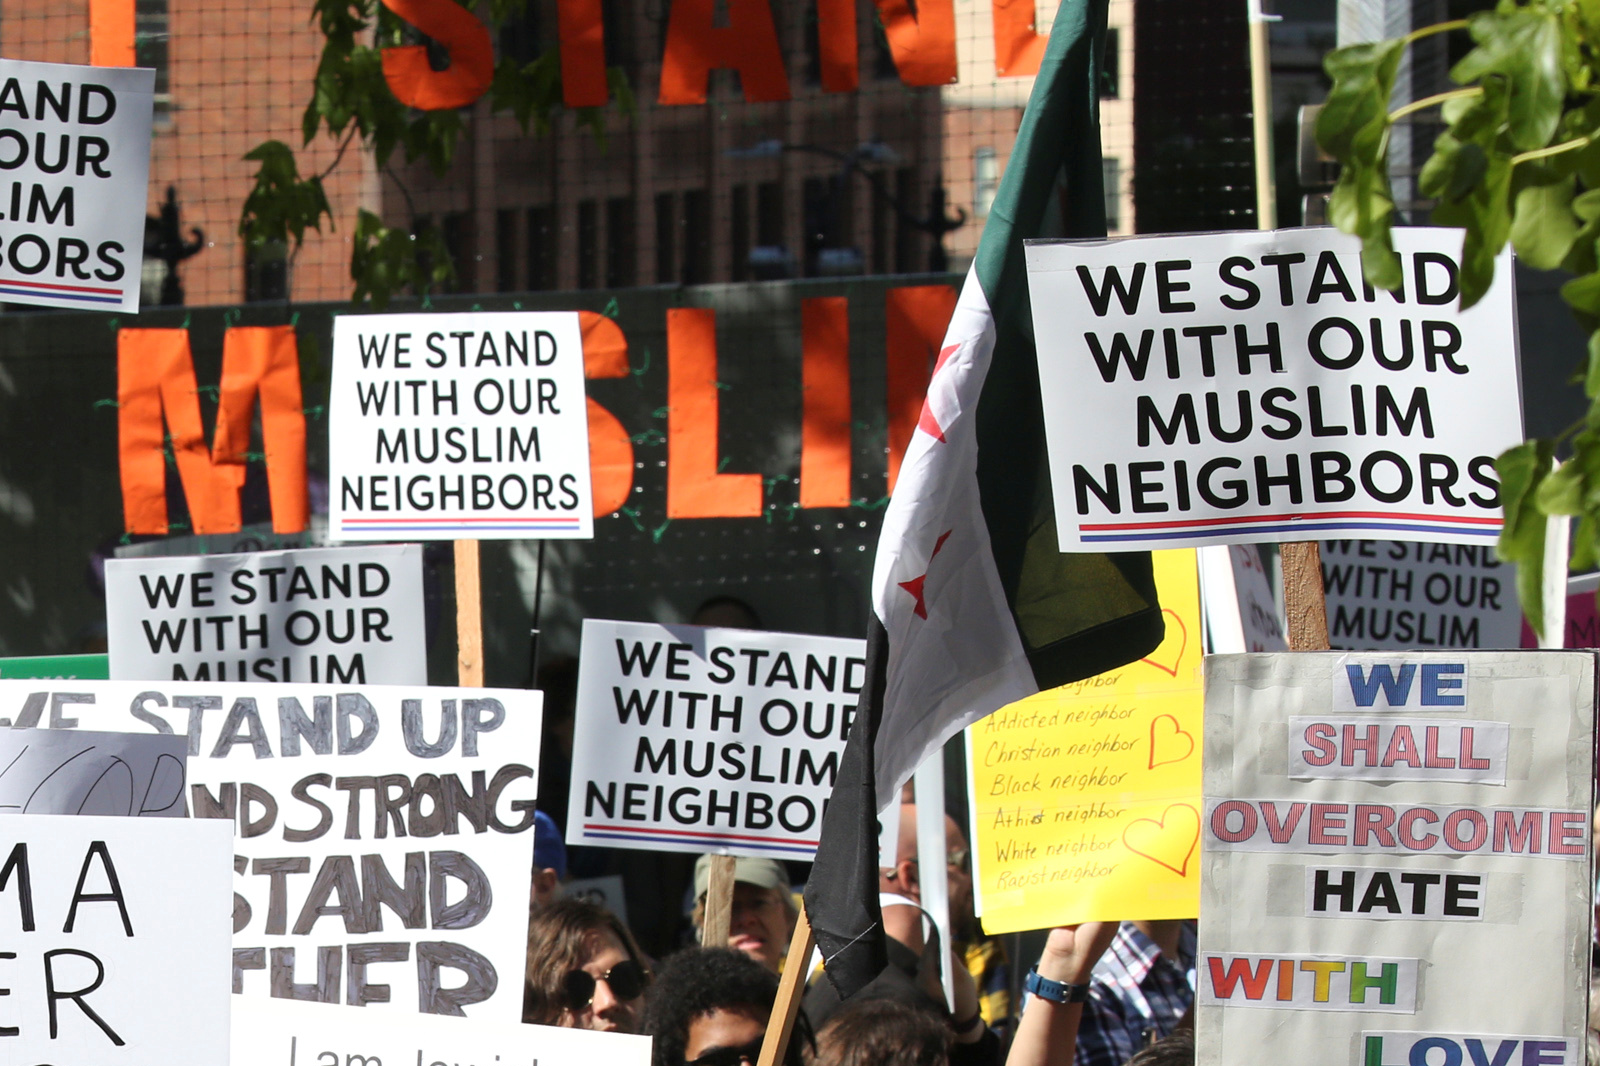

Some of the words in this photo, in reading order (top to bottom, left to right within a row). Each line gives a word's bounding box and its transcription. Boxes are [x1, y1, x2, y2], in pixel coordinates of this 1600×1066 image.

[1075, 259, 1197, 317] WE
[358, 333, 411, 369] WE
[425, 331, 559, 368] STAND
[1084, 323, 1285, 383] WITH
[1307, 316, 1469, 375] OUR
[356, 380, 460, 416] WITH
[473, 378, 562, 415] OUR
[1136, 384, 1436, 447] MUSLIM
[375, 427, 542, 464] MUSLIM
[341, 473, 580, 513] NEIGHBORS
[1072, 451, 1502, 516] NEIGHBORS
[139, 572, 215, 609] WE
[231, 563, 390, 604] STAND
[1322, 563, 1414, 600] WITH
[1424, 573, 1502, 610] OUR
[142, 614, 268, 654] WITH
[285, 608, 392, 646] OUR
[1333, 605, 1480, 648] MUSLIM
[615, 638, 693, 681] WE
[1346, 663, 1467, 708] WE
[401, 697, 506, 759] UP
[613, 686, 743, 733] WITH
[984, 707, 1059, 734] Addicted
[1065, 704, 1136, 727] neighbor
[634, 736, 838, 788] MUSLIM
[984, 738, 1060, 768] Christian
[1067, 735, 1141, 760] neighbor
[1301, 722, 1490, 770] SHALL
[283, 763, 538, 843] STRONG
[990, 773, 1042, 796] Black
[1050, 765, 1129, 791] neighbor
[1054, 802, 1128, 825] neighbor
[1210, 800, 1586, 857] OVERCOME
[995, 838, 1037, 863] White
[1046, 834, 1119, 857] neighbor
[62, 840, 135, 938] A
[997, 865, 1047, 890] Racist
[1049, 861, 1120, 885] neighbor
[1313, 870, 1481, 916] HATE
[1207, 957, 1398, 1005] WITH
